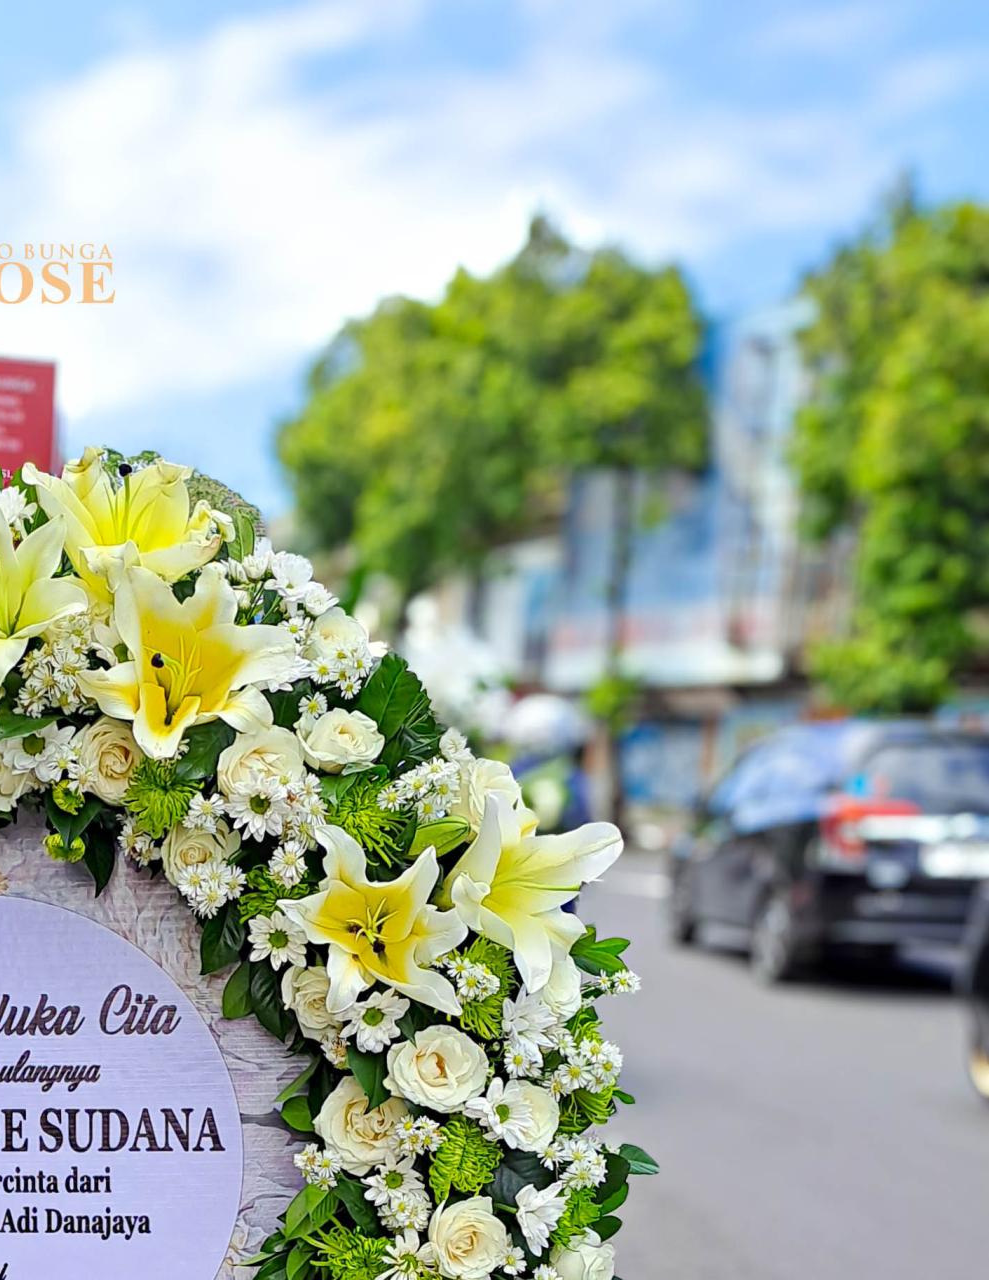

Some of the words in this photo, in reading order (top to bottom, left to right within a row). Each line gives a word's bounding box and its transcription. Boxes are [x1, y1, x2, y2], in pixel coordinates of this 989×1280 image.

[98, 983, 181, 1036] Cita
[38, 1107, 226, 1154] SUDANA
[64, 1166, 112, 1194] dari
[44, 1206, 152, 1241] Danajaya
